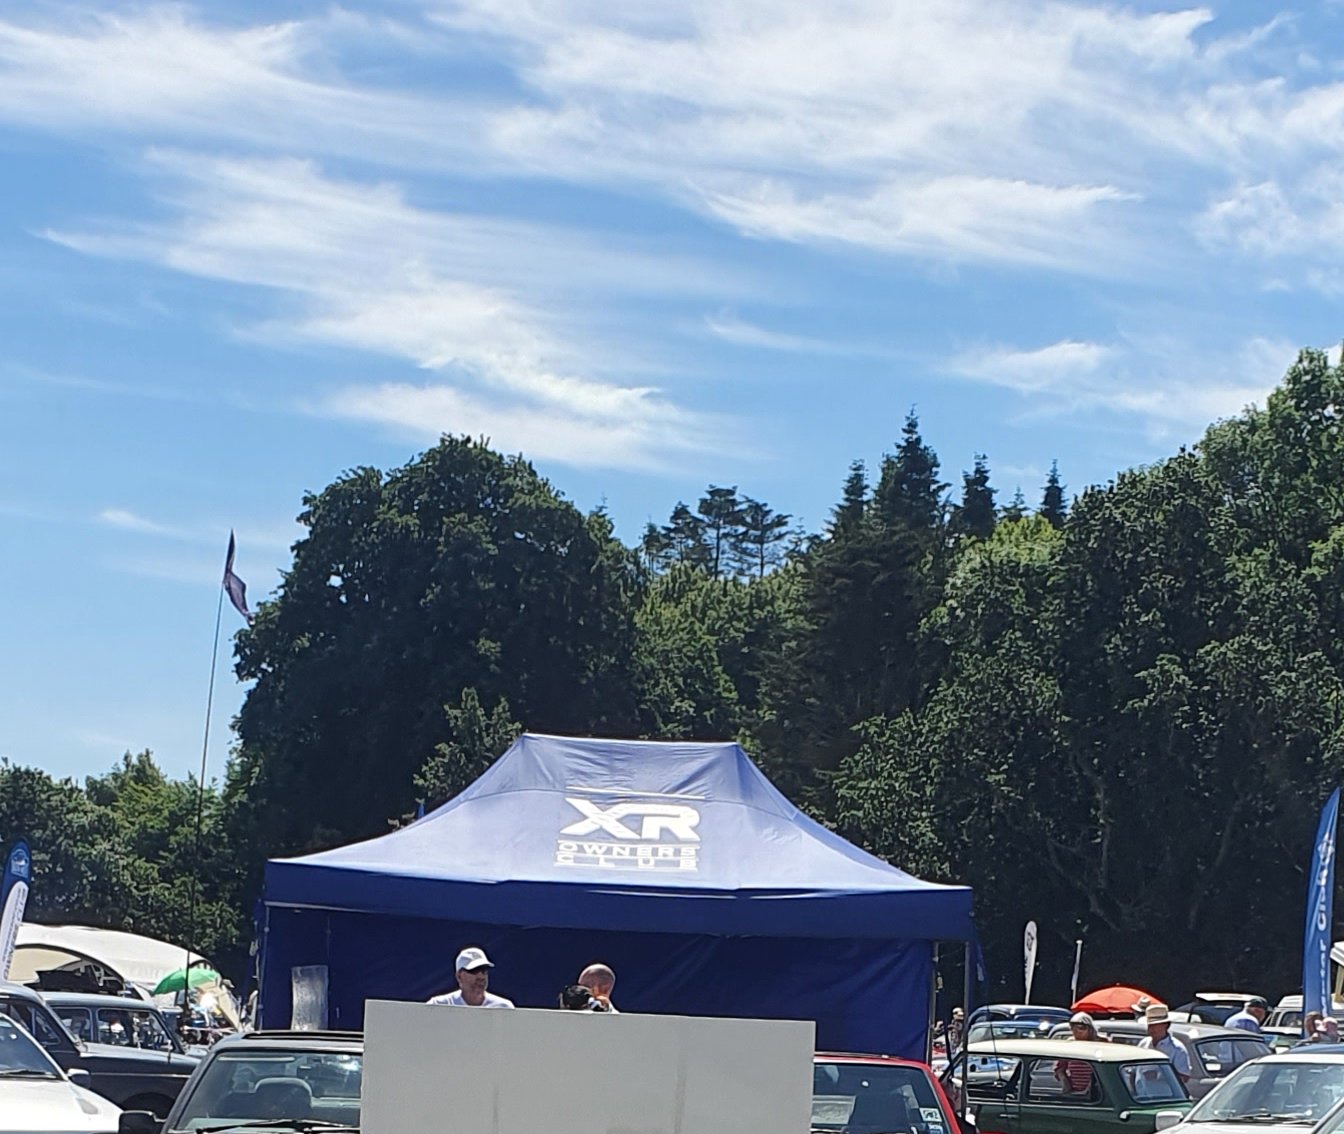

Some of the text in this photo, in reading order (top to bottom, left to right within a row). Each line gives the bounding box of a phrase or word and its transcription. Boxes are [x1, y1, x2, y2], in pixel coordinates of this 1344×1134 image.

[560, 797, 701, 841] XR
[558, 842, 697, 858] OWNERS
[556, 854, 697, 869] CLUB
